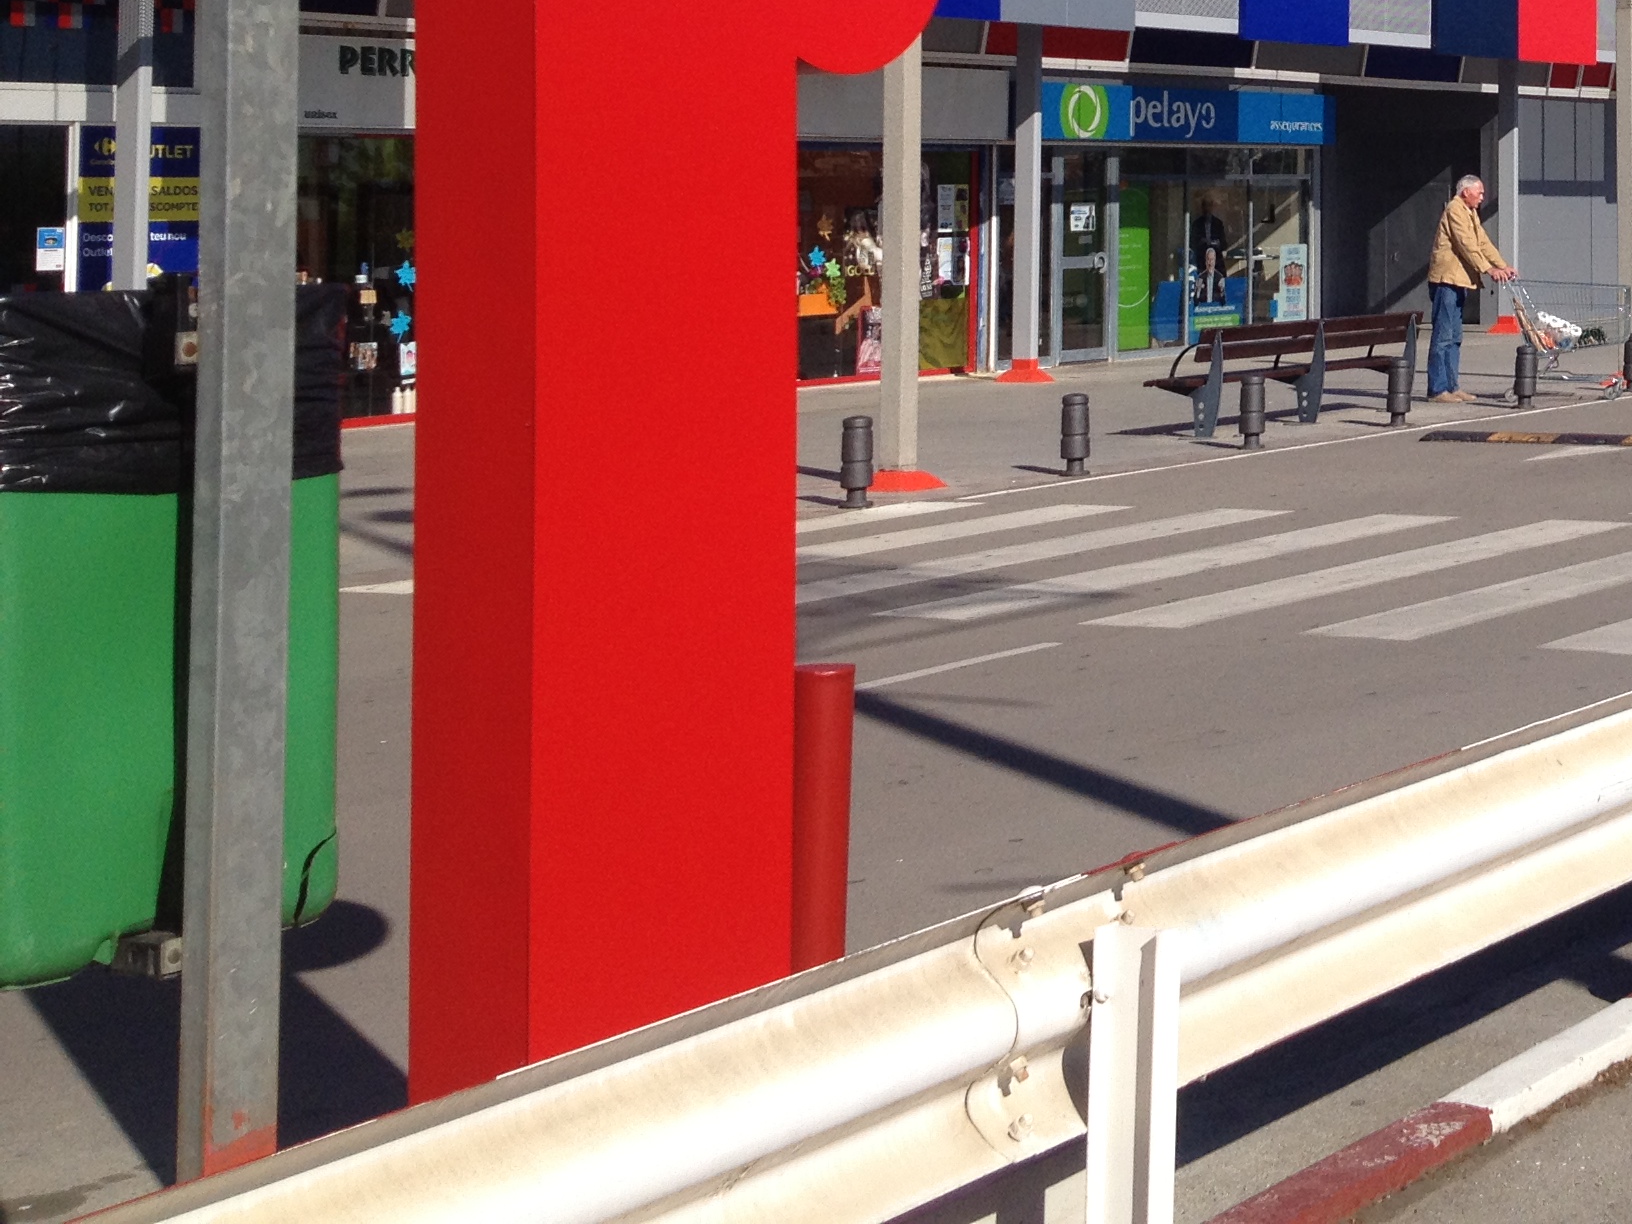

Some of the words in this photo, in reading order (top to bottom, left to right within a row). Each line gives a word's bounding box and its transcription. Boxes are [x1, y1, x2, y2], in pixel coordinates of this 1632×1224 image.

[339, 45, 416, 77] PERR
[1129, 90, 1216, 138] pelayo
[149, 143, 193, 158] UTLET
[89, 186, 114, 196] VEN
[151, 185, 198, 196] SALDOS
[89, 202, 109, 212] TOT
[149, 202, 198, 212] SCOMPTE
[83, 232, 113, 242] Desco
